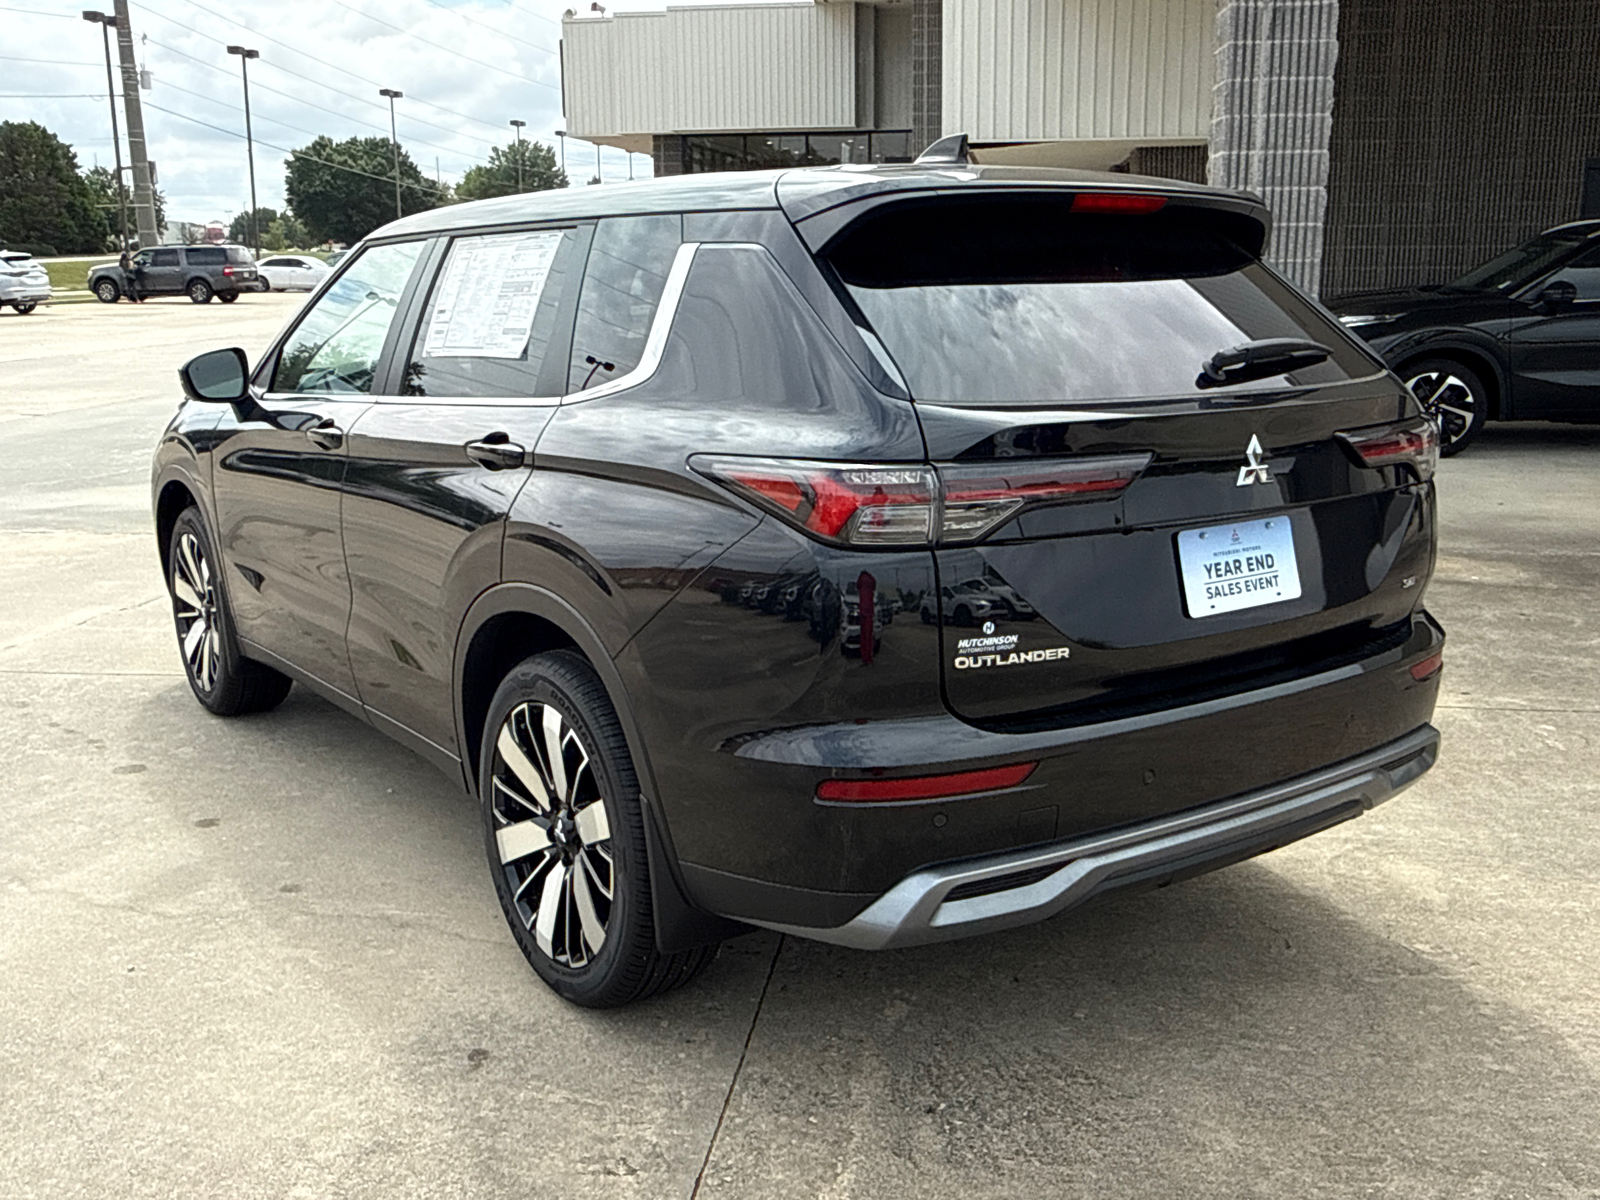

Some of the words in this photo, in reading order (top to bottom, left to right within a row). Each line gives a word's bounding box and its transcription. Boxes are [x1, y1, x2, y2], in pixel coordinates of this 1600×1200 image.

[1213, 549, 1241, 557] MITSUBISHI
[1203, 559, 1243, 579] YEAR
[1246, 553, 1275, 573] END
[1206, 582, 1242, 600] SALES
[1244, 574, 1279, 592] EVENT
[957, 634, 1019, 648] HUTCHINSON
[958, 646, 995, 654] AUTOMOTIVE
[996, 643, 1016, 651] GROUP
[954, 647, 1070, 669] OUTLANDER
